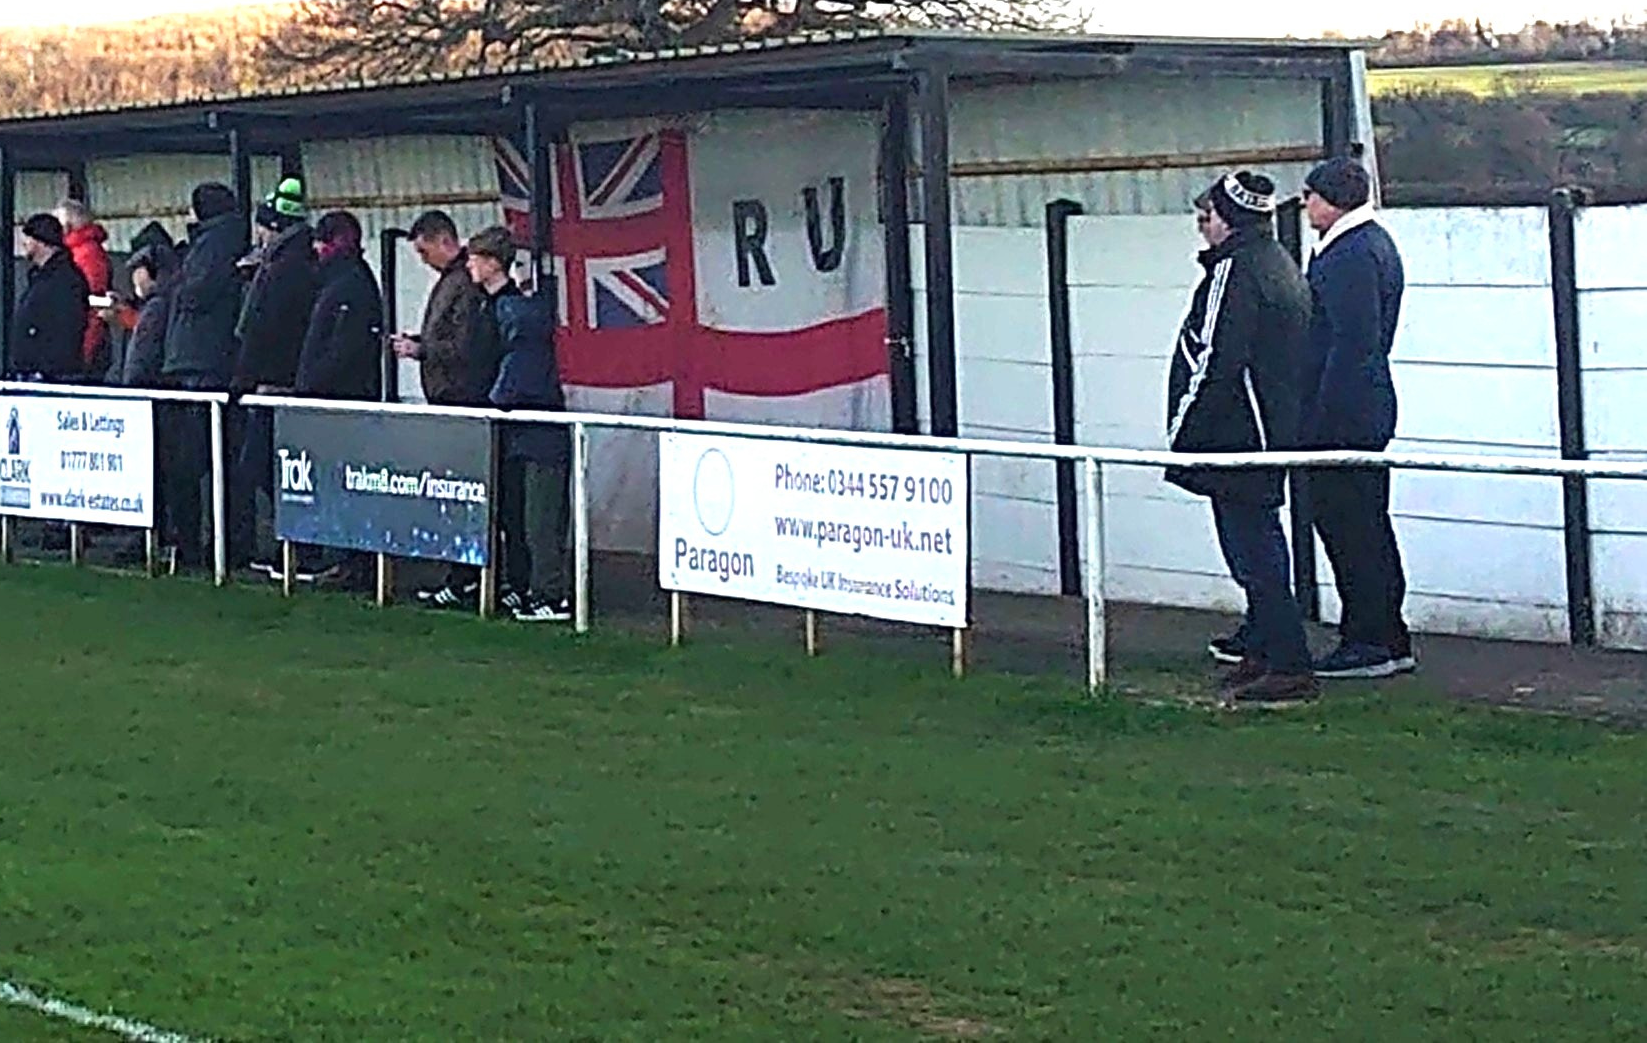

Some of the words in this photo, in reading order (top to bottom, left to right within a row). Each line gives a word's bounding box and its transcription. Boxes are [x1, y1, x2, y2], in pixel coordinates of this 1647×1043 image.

[57, 410, 80, 432] Sales
[90, 412, 125, 439] Lettings
[278, 449, 313, 492] Trak
[345, 464, 487, 503] trakm8.com/insurance
[774, 463, 825, 494] Phone:
[828, 469, 864, 498] 0344
[869, 474, 899, 501] 557
[905, 476, 953, 505] 9100
[774, 516, 953, 555] www.paragon-uk.net
[675, 537, 754, 583] Paragon
[776, 564, 819, 591] Bespoke
[820, 570, 836, 589] UK
[838, 572, 892, 598] Insurance
[894, 578, 956, 606] Solutions
